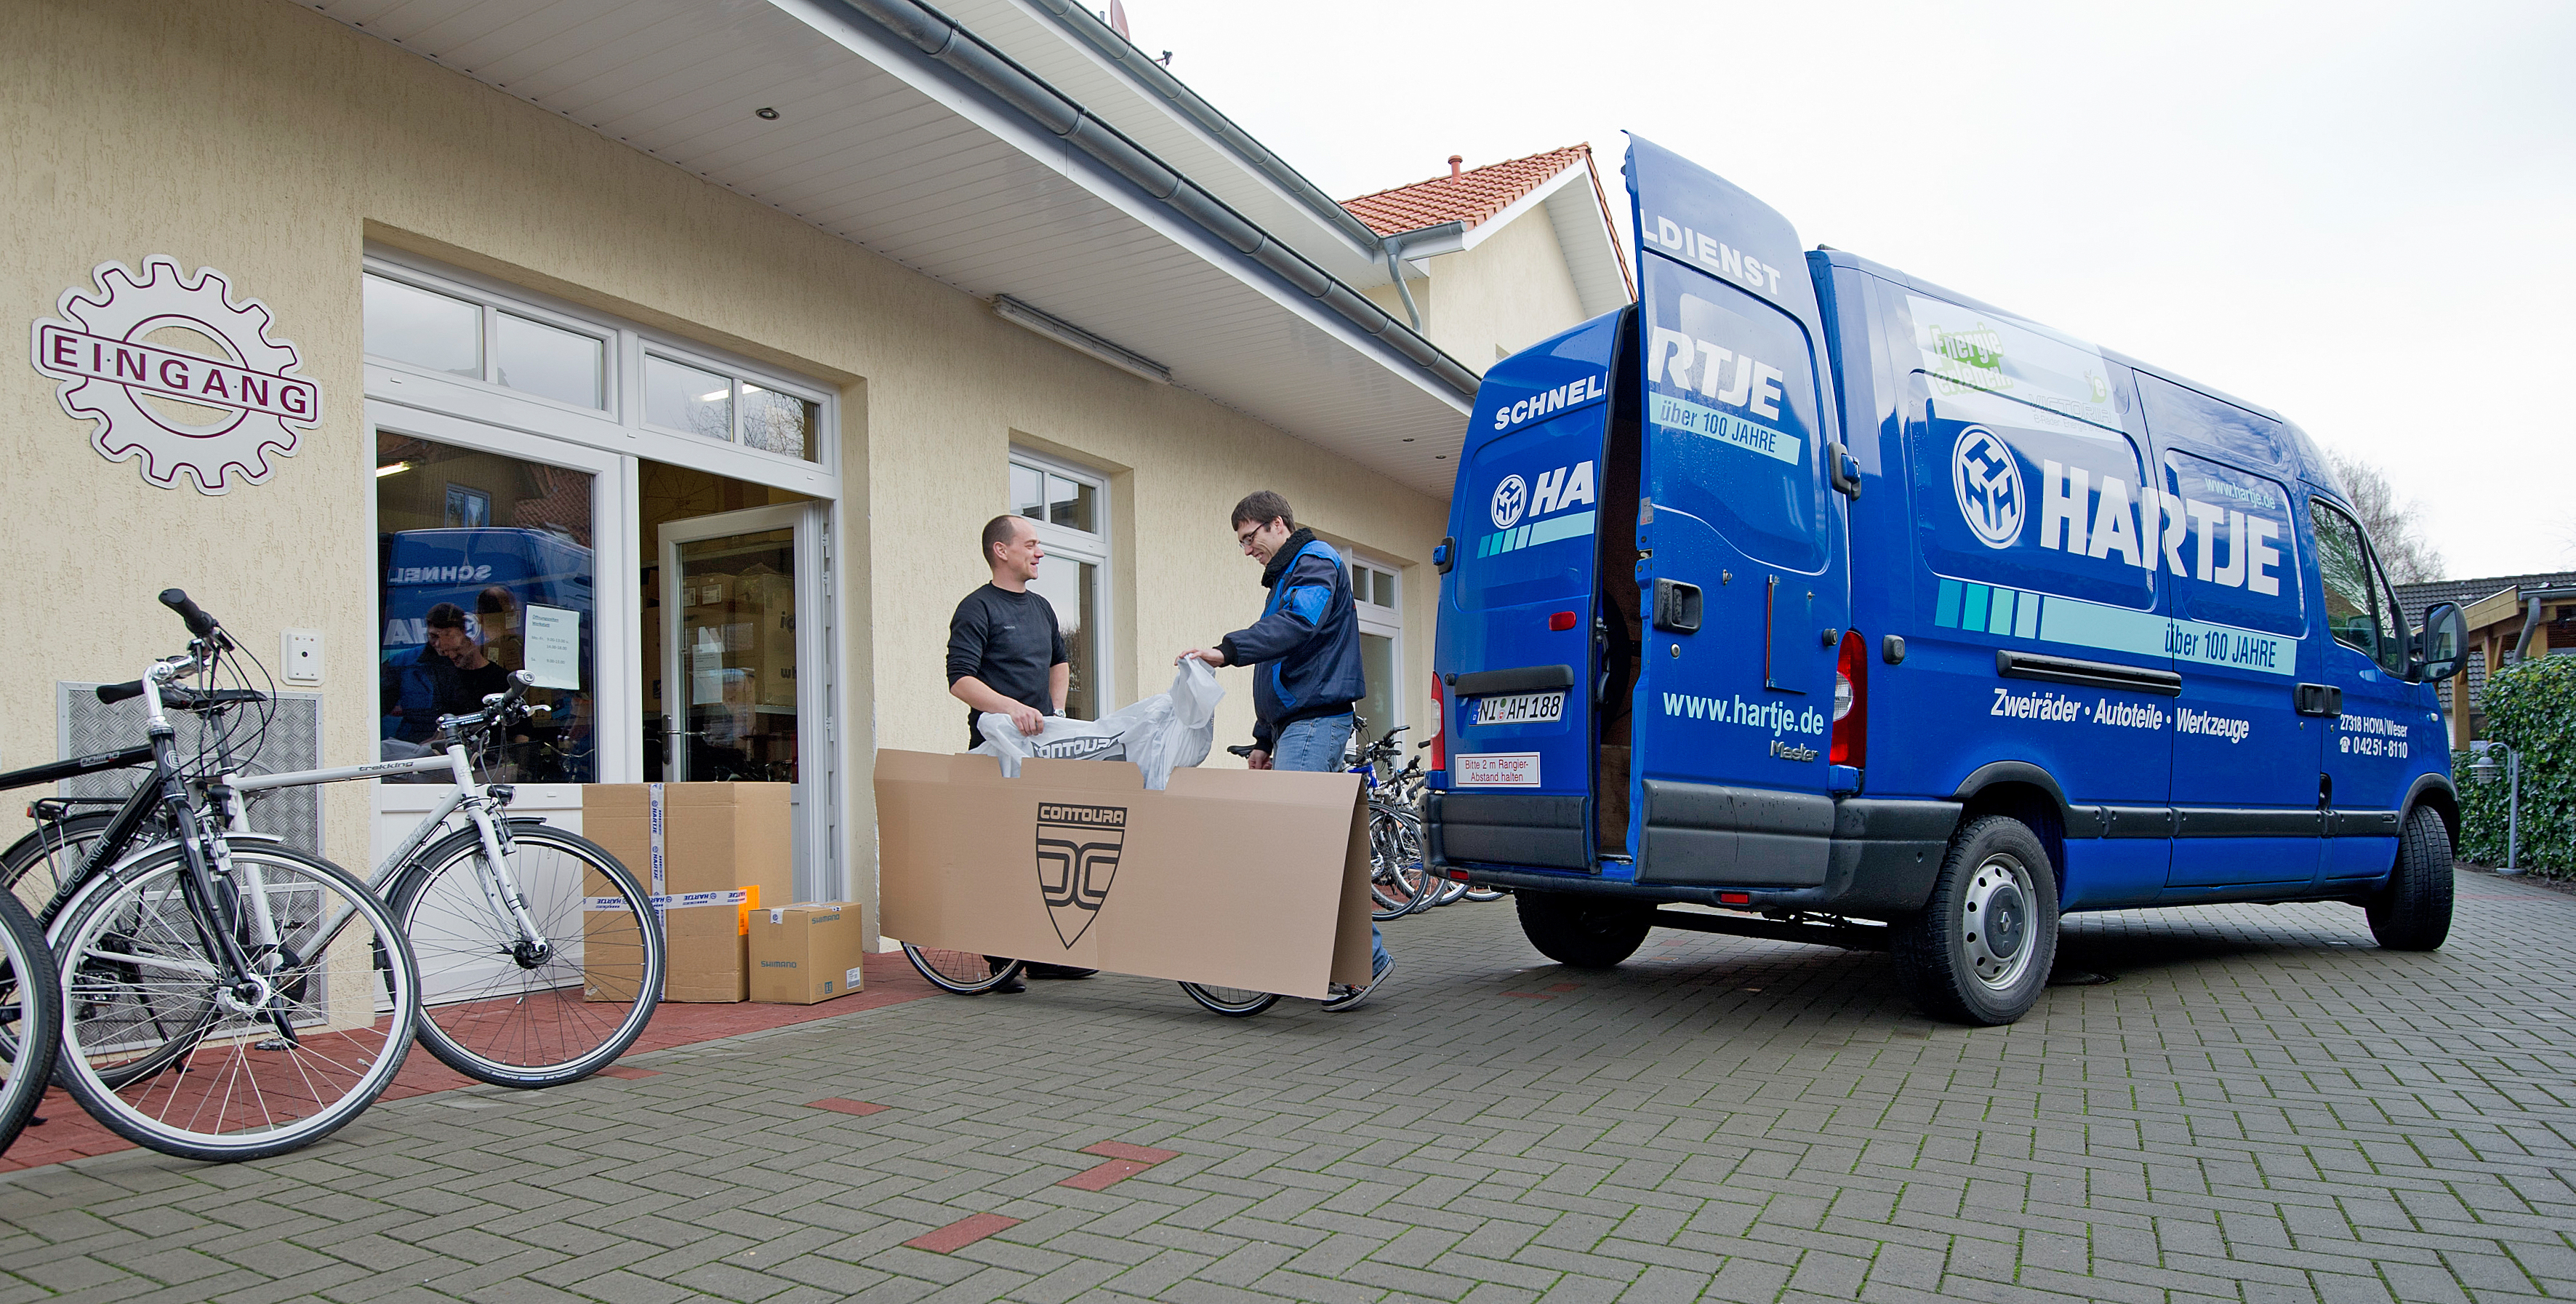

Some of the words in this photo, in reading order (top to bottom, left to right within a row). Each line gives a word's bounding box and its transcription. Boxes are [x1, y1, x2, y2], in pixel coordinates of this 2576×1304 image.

[1930, 324, 2002, 364] Energie
[53, 333, 308, 416] EINGANG
[1648, 326, 1783, 422] RTJE
[2029, 393, 2111, 423] VICTORIA
[1661, 400, 1698, 428] über
[1704, 412, 1728, 437] 100
[1731, 420, 1777, 454] JAHRE
[1528, 460, 1594, 518] HA
[2204, 477, 2276, 509] www.hartje.de
[2040, 458, 2279, 596] HARTJE
[2164, 623, 2198, 656] über
[2204, 630, 2228, 662] 100
[2231, 636, 2276, 669] JAHRE
[1479, 700, 1497, 721] NI
[1506, 697, 1529, 719] AH
[1529, 695, 1561, 719] 188
[1663, 692, 1823, 737] www.hartje.de
[1991, 688, 2081, 722] Zweiräder
[2093, 698, 2162, 730] Autoteile
[2177, 707, 2250, 744] Werkzeuge
[2340, 713, 2362, 732] 27318
[2363, 716, 2408, 737] HOYA/Weser
[358, 761, 414, 771] trekking
[1465, 759, 1480, 769] Bitte
[1482, 759, 1488, 769] 2
[1498, 759, 1528, 772] Rangier-
[1770, 740, 1819, 762] Master
[1470, 772, 1498, 782] Abstand
[1501, 772, 1523, 782] halten
[1040, 806, 1124, 824] CONTOURA
[683, 893, 709, 901] HARTJE
[811, 913, 840, 924] SHIMANO
